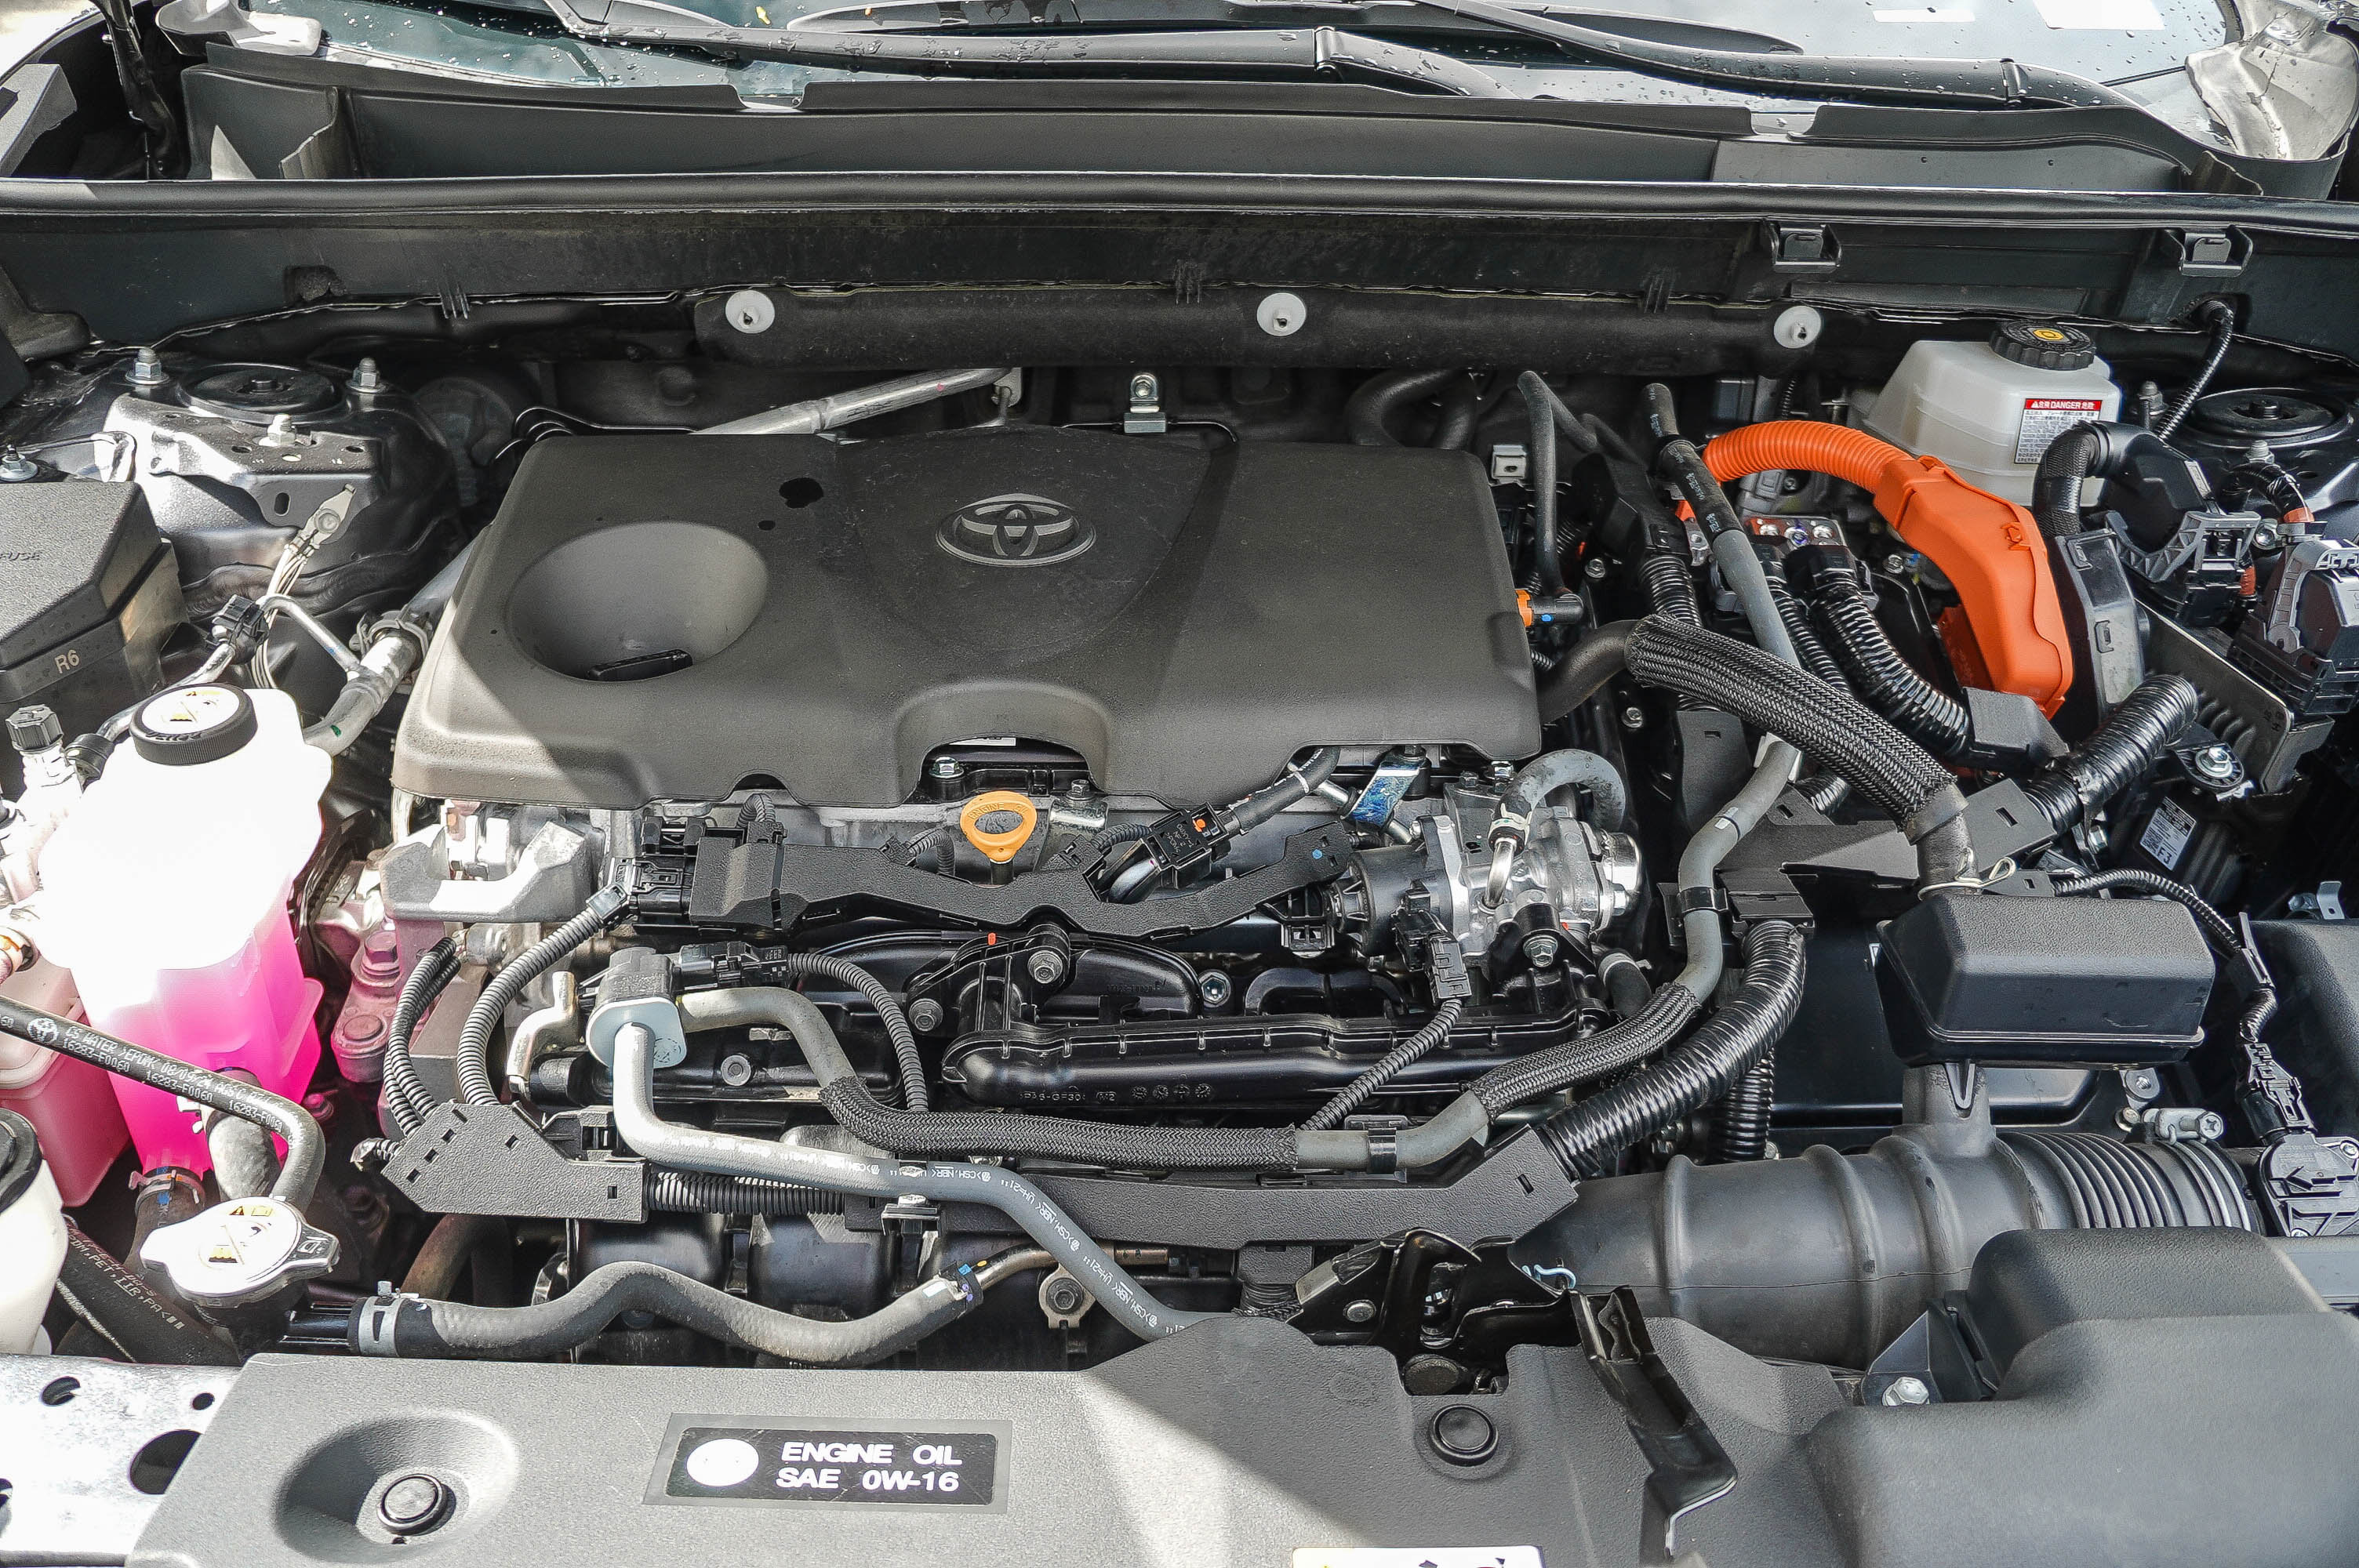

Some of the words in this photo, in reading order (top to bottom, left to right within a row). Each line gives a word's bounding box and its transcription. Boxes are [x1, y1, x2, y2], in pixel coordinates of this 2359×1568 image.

[55, 649, 79, 674] R6
[967, 802, 1005, 820] ENGINE
[83, 1033, 118, 1054] WATER
[781, 1442, 894, 1464] ENGINE
[912, 1445, 963, 1465] OIL
[776, 1467, 841, 1489] SAE
[862, 1470, 960, 1492] 0W-16
